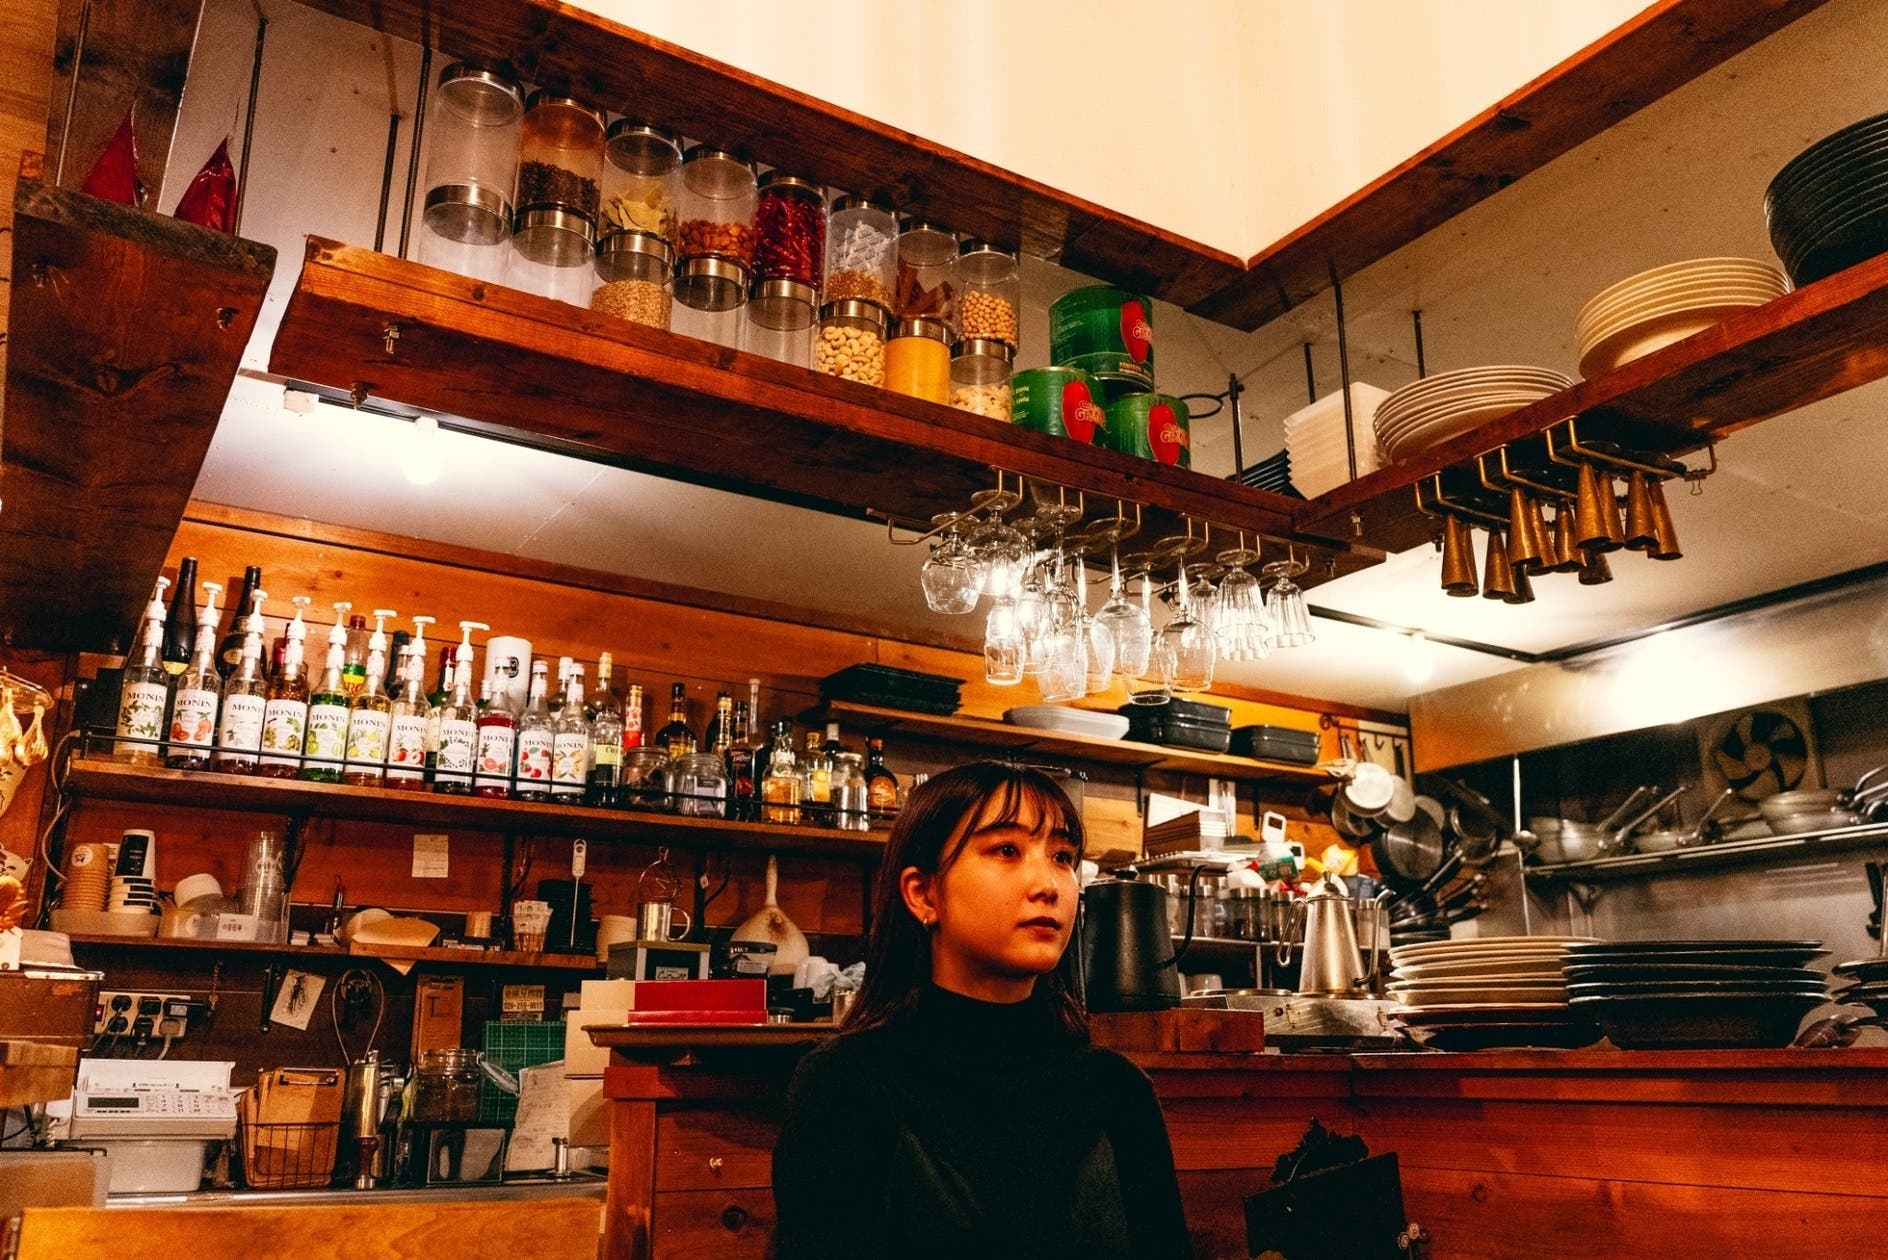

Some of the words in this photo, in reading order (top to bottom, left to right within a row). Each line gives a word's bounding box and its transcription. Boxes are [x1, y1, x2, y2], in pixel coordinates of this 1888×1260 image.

[127, 692, 164, 702] MONIN
[177, 699, 212, 708] MONIN
[268, 708, 303, 718] MONIN
